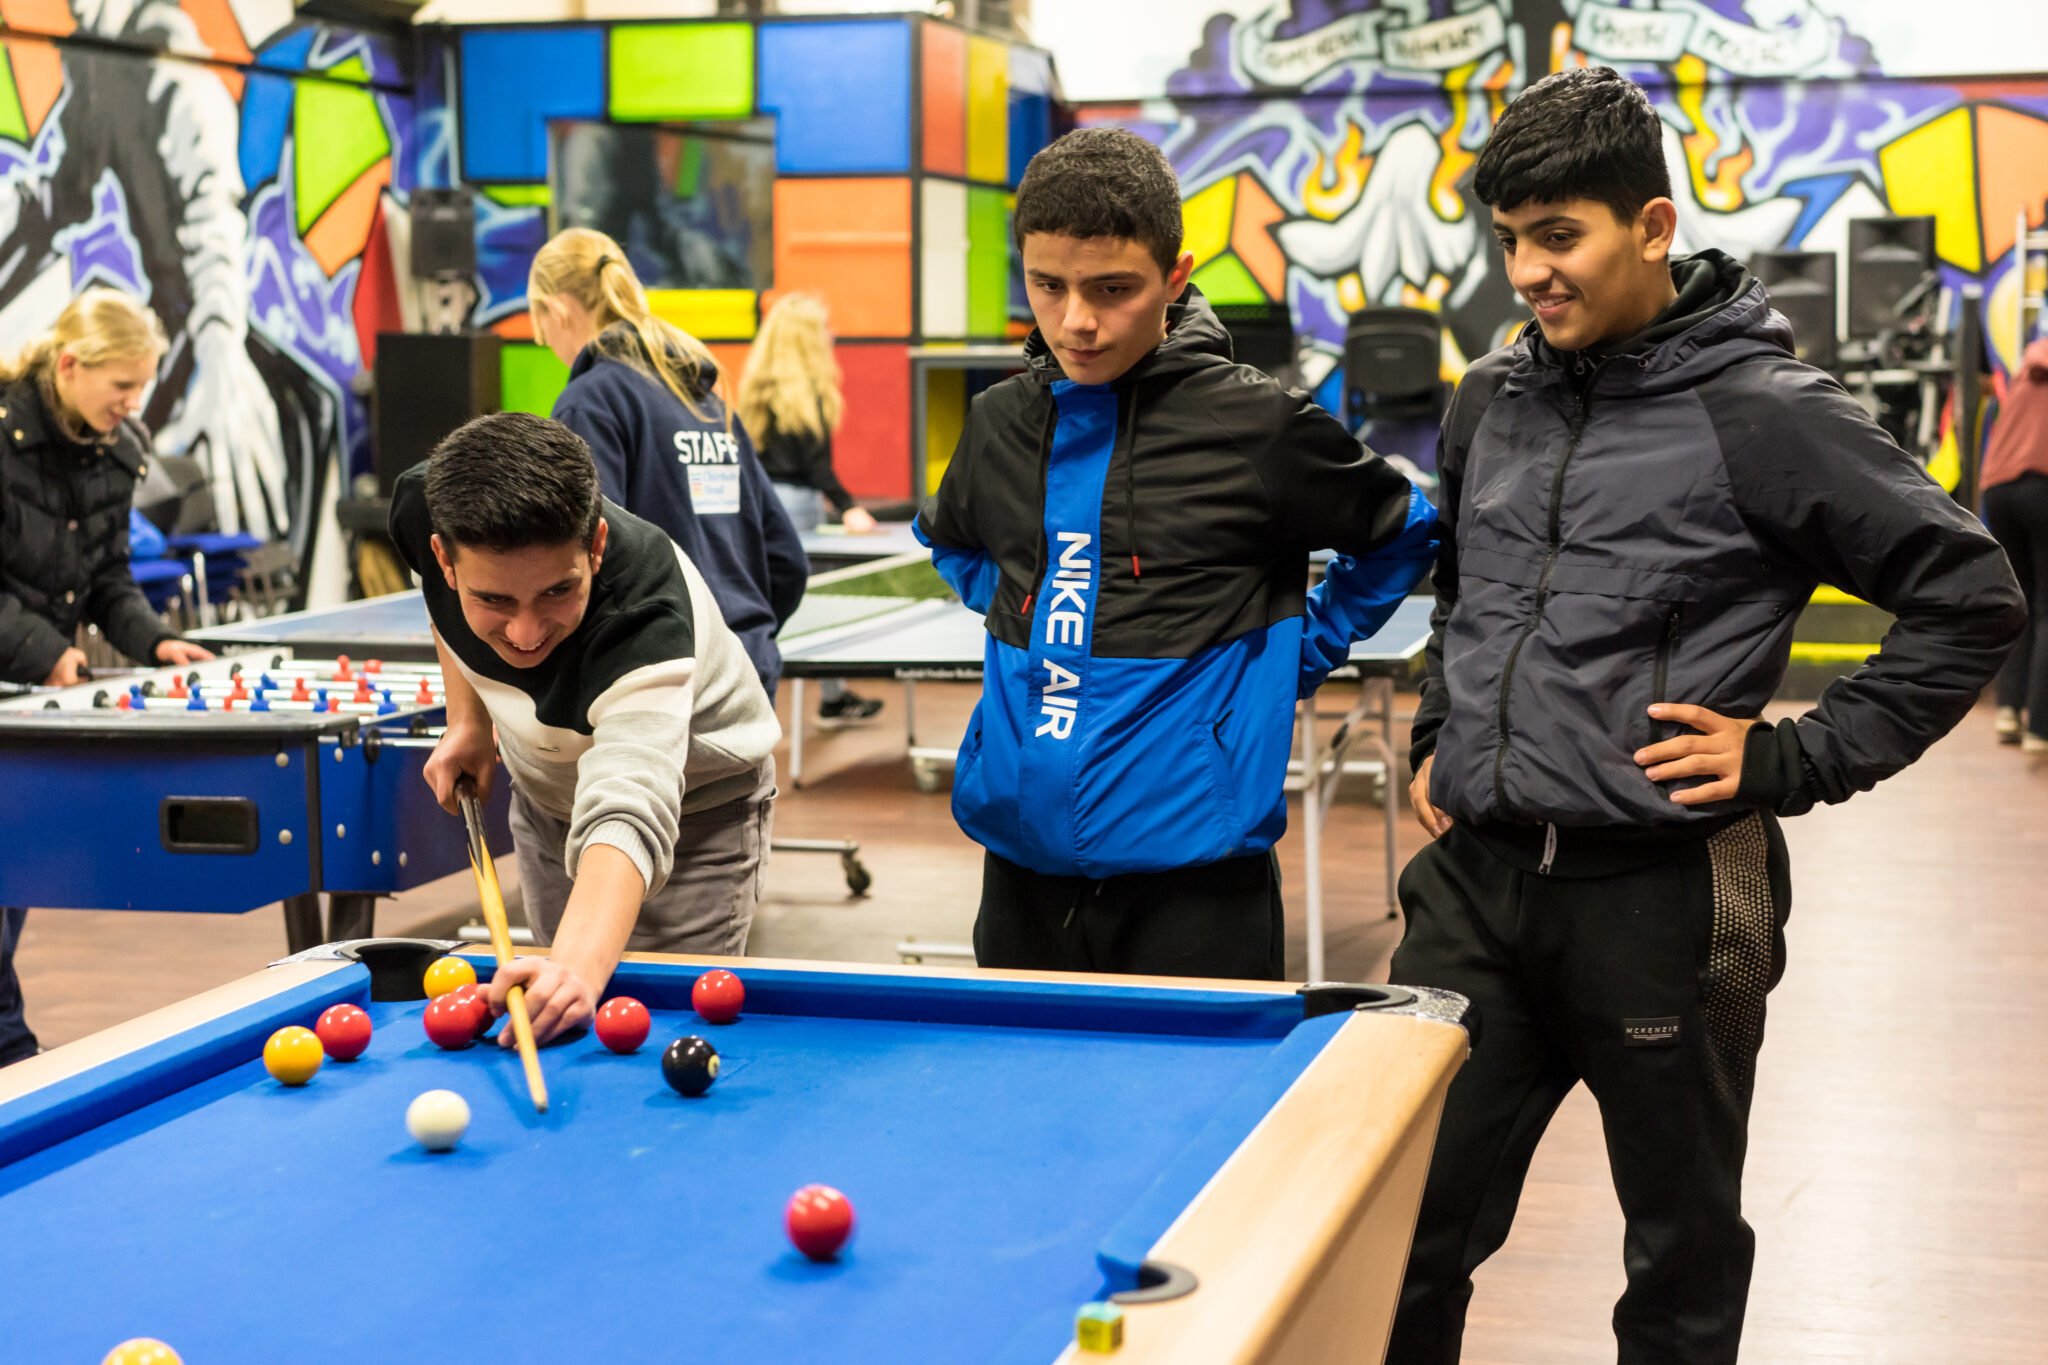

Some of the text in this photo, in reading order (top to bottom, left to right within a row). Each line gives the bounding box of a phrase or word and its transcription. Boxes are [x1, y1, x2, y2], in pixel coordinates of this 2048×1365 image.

[673, 431, 739, 465] STAFF
[1035, 531, 1092, 741] NIKE AIR
[1625, 1025, 1679, 1034] MCKENZIE
